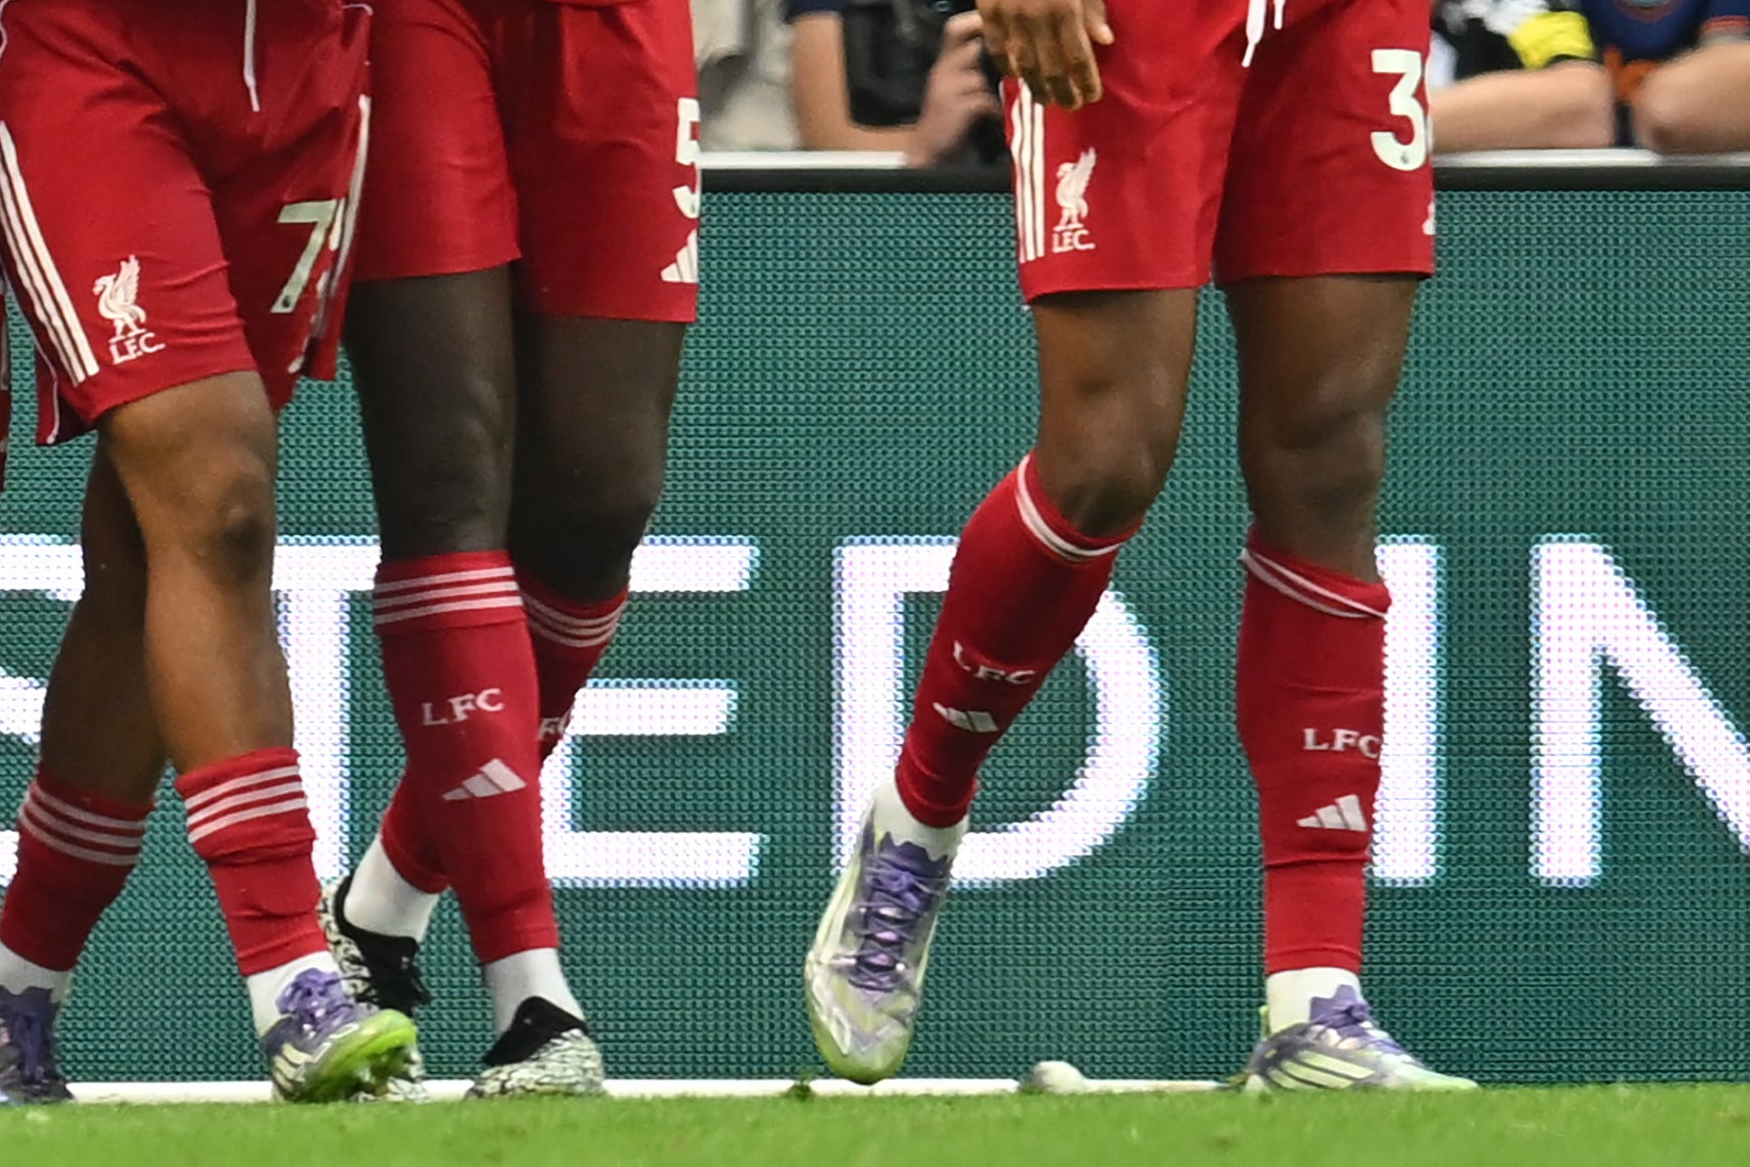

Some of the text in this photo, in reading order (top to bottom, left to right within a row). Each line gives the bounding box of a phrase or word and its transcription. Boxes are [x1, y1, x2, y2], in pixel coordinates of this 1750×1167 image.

[1370, 48, 1432, 171] 3
[270, 198, 346, 316] 7
[422, 688, 506, 727] LFC
[1303, 728, 1381, 759] LFC
